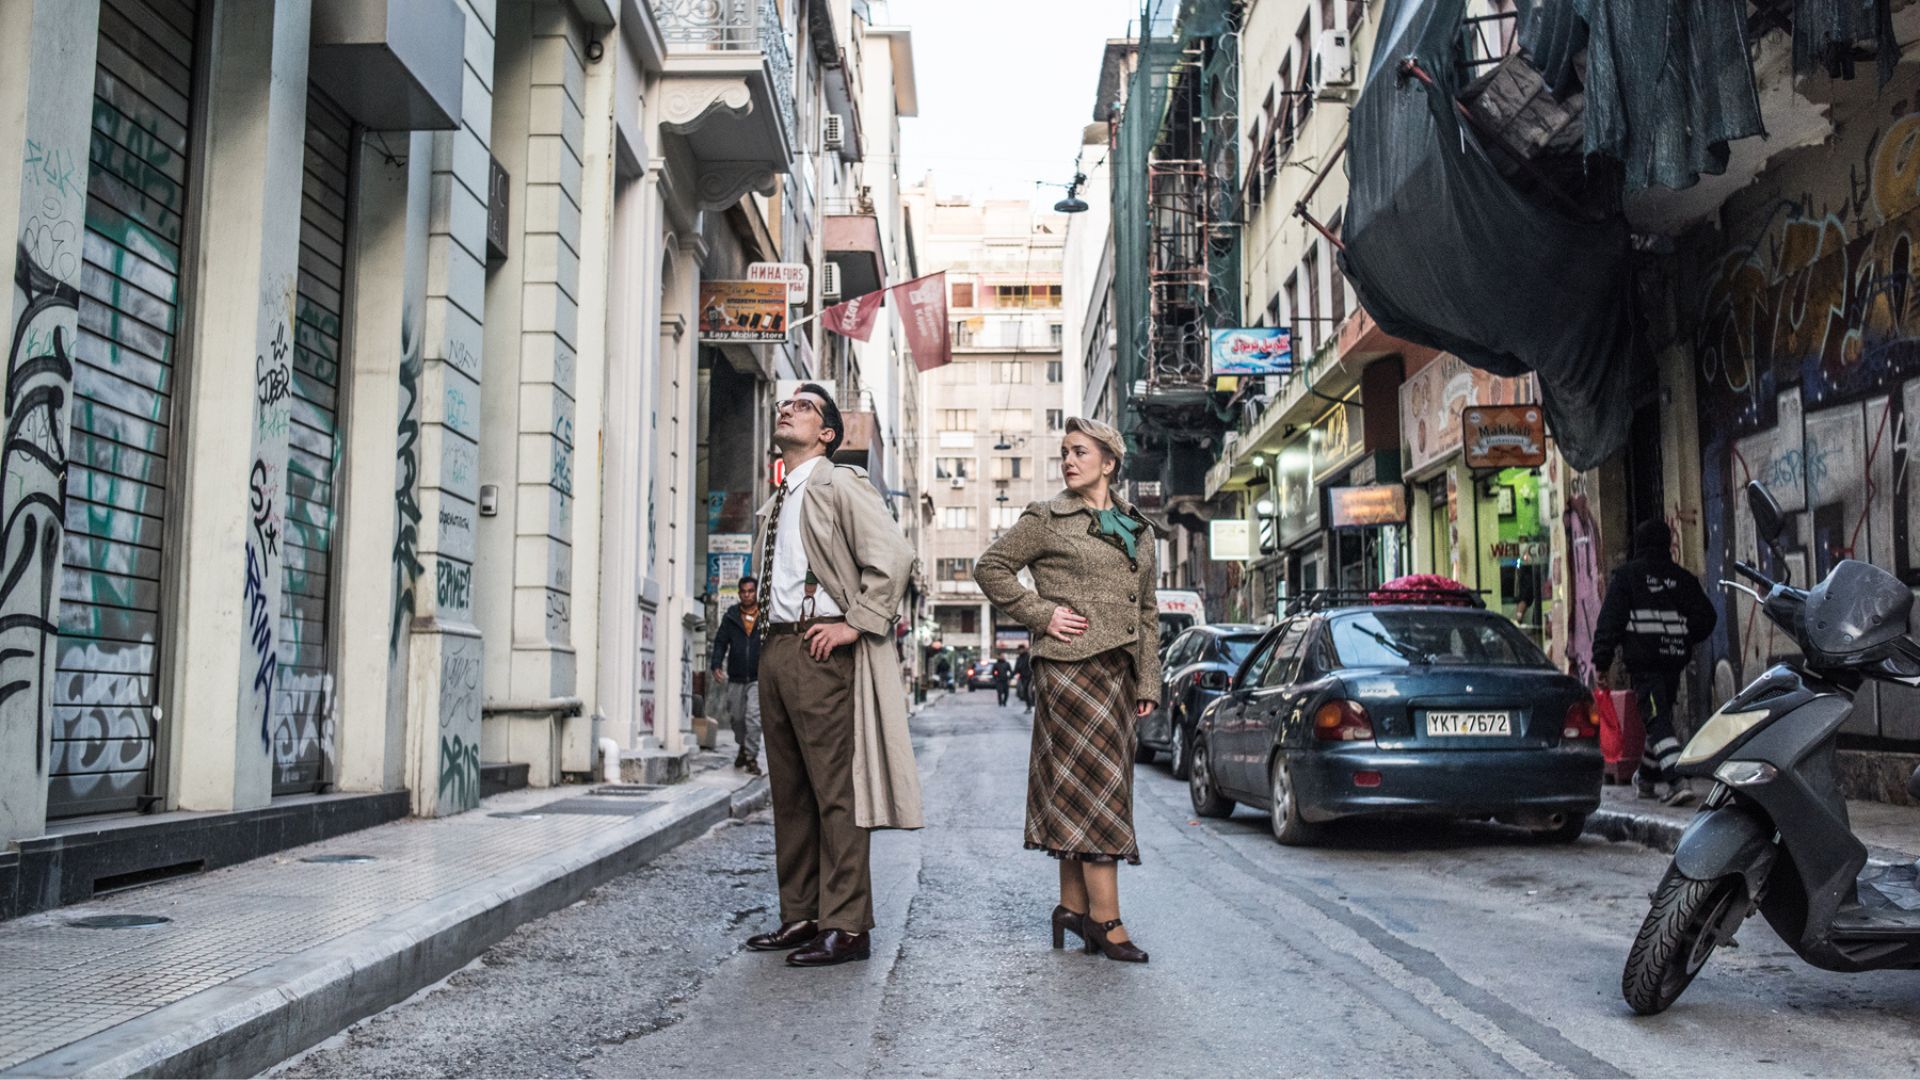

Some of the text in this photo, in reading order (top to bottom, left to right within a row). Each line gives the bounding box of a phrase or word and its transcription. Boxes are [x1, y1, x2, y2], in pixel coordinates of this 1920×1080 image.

[709, 331, 784, 340] Easy Mobile Store
[1431, 714, 1507, 732] YKT 7672
